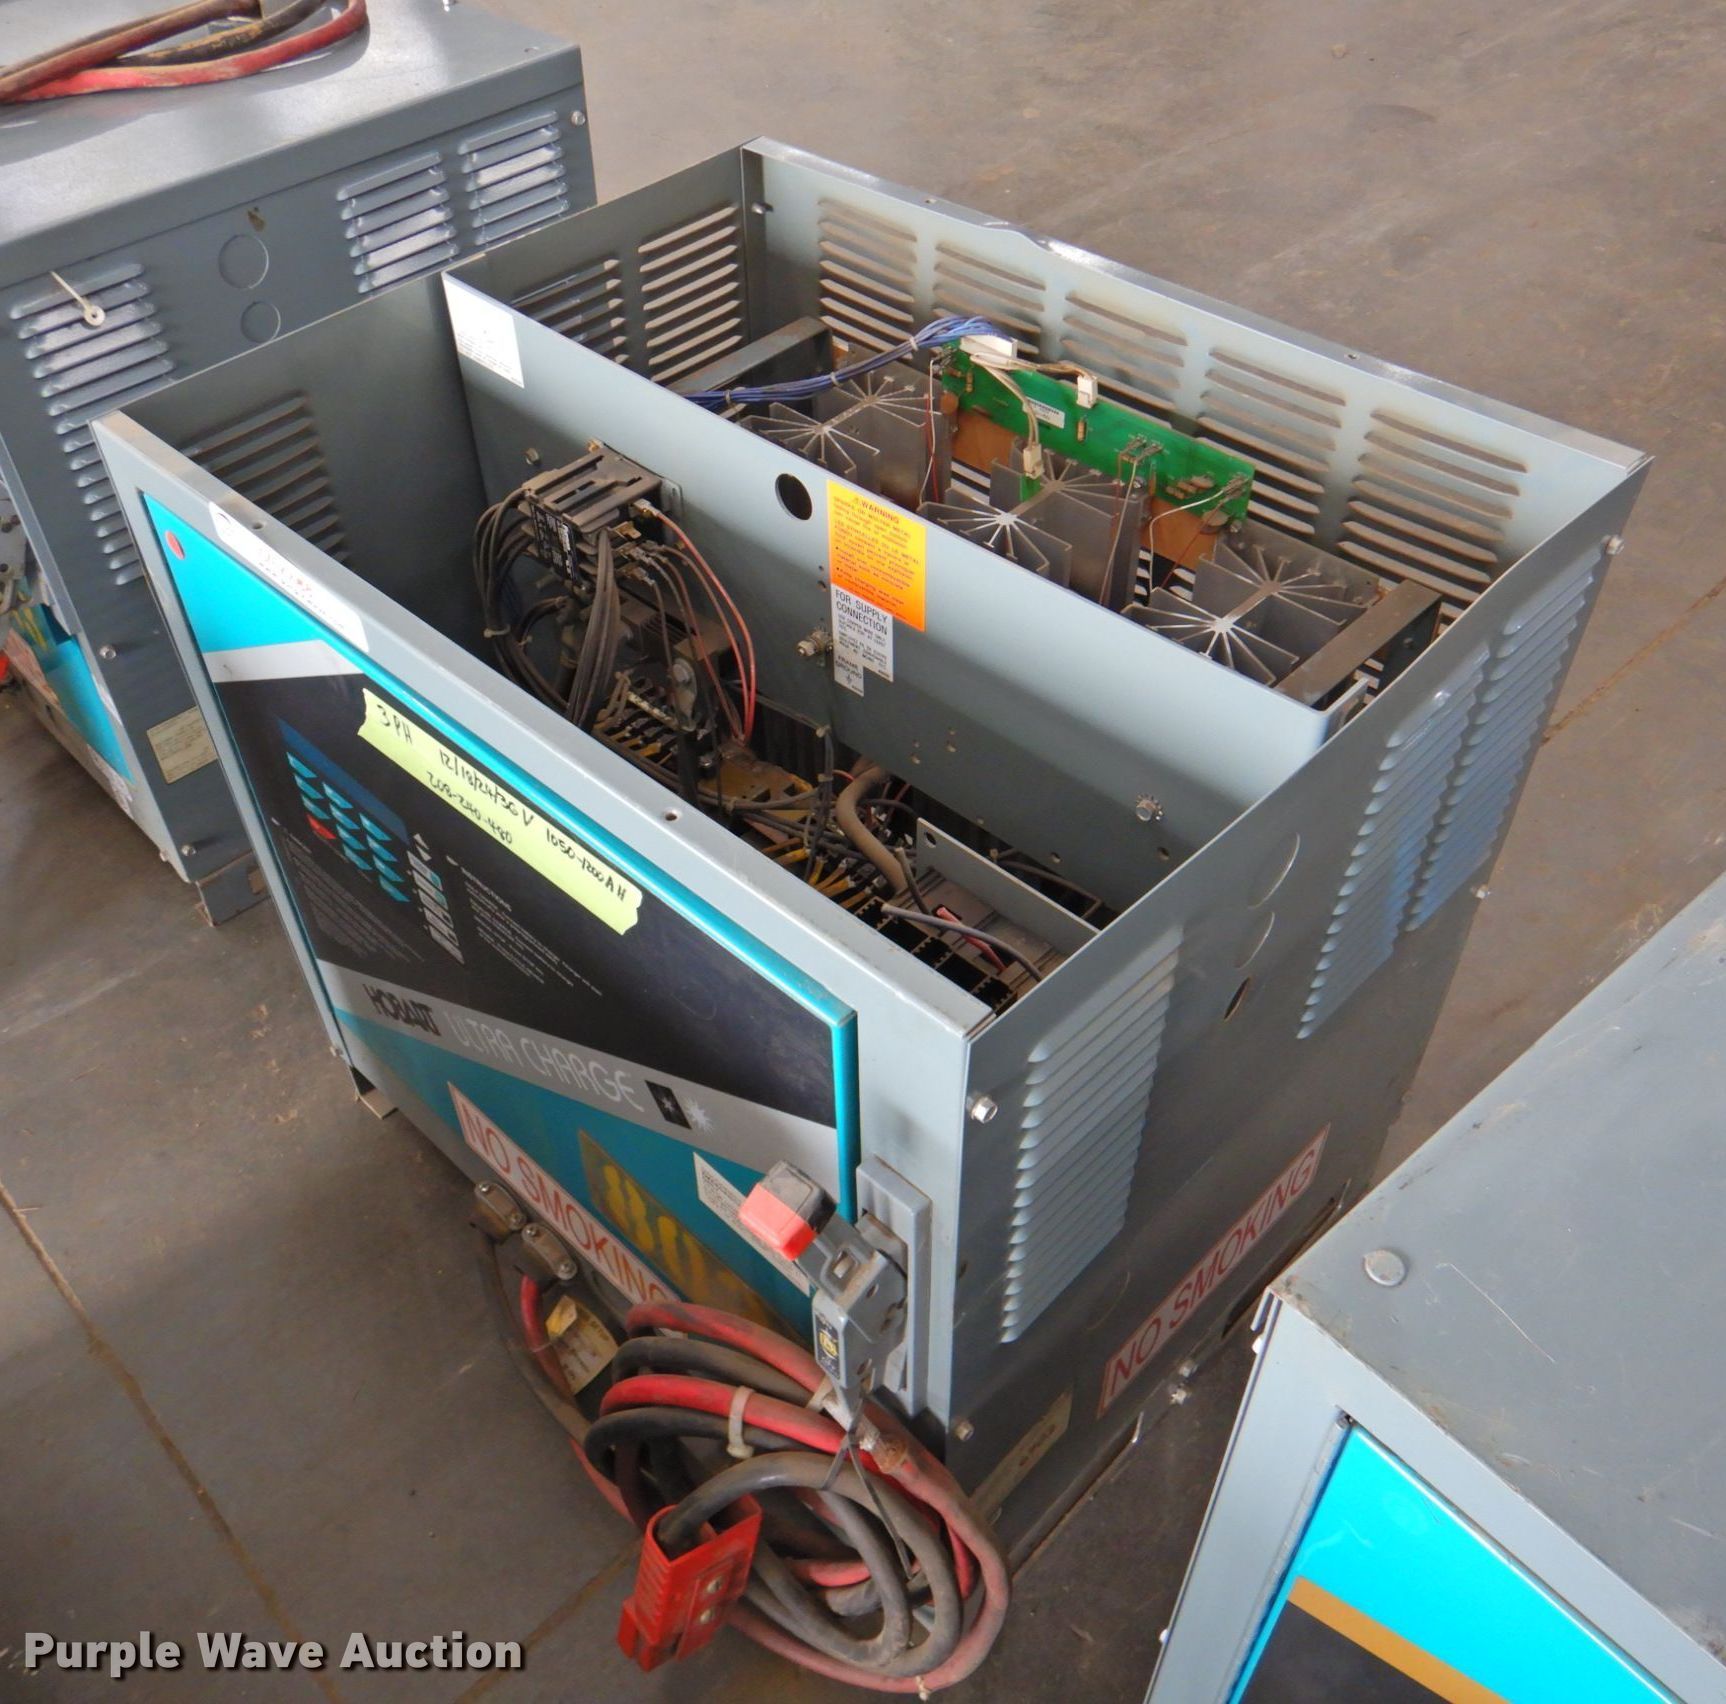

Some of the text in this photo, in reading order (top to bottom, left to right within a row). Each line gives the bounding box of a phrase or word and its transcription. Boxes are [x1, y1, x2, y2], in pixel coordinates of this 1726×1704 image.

[835, 589, 888, 623] FOR SUPPLY
[836, 600, 888, 635] CONNECTION
[362, 984, 645, 1113] HOBART ULTRA CHARGE
[461, 1102, 511, 1175] NO
[1109, 1149, 1316, 1397] NO SMOKING
